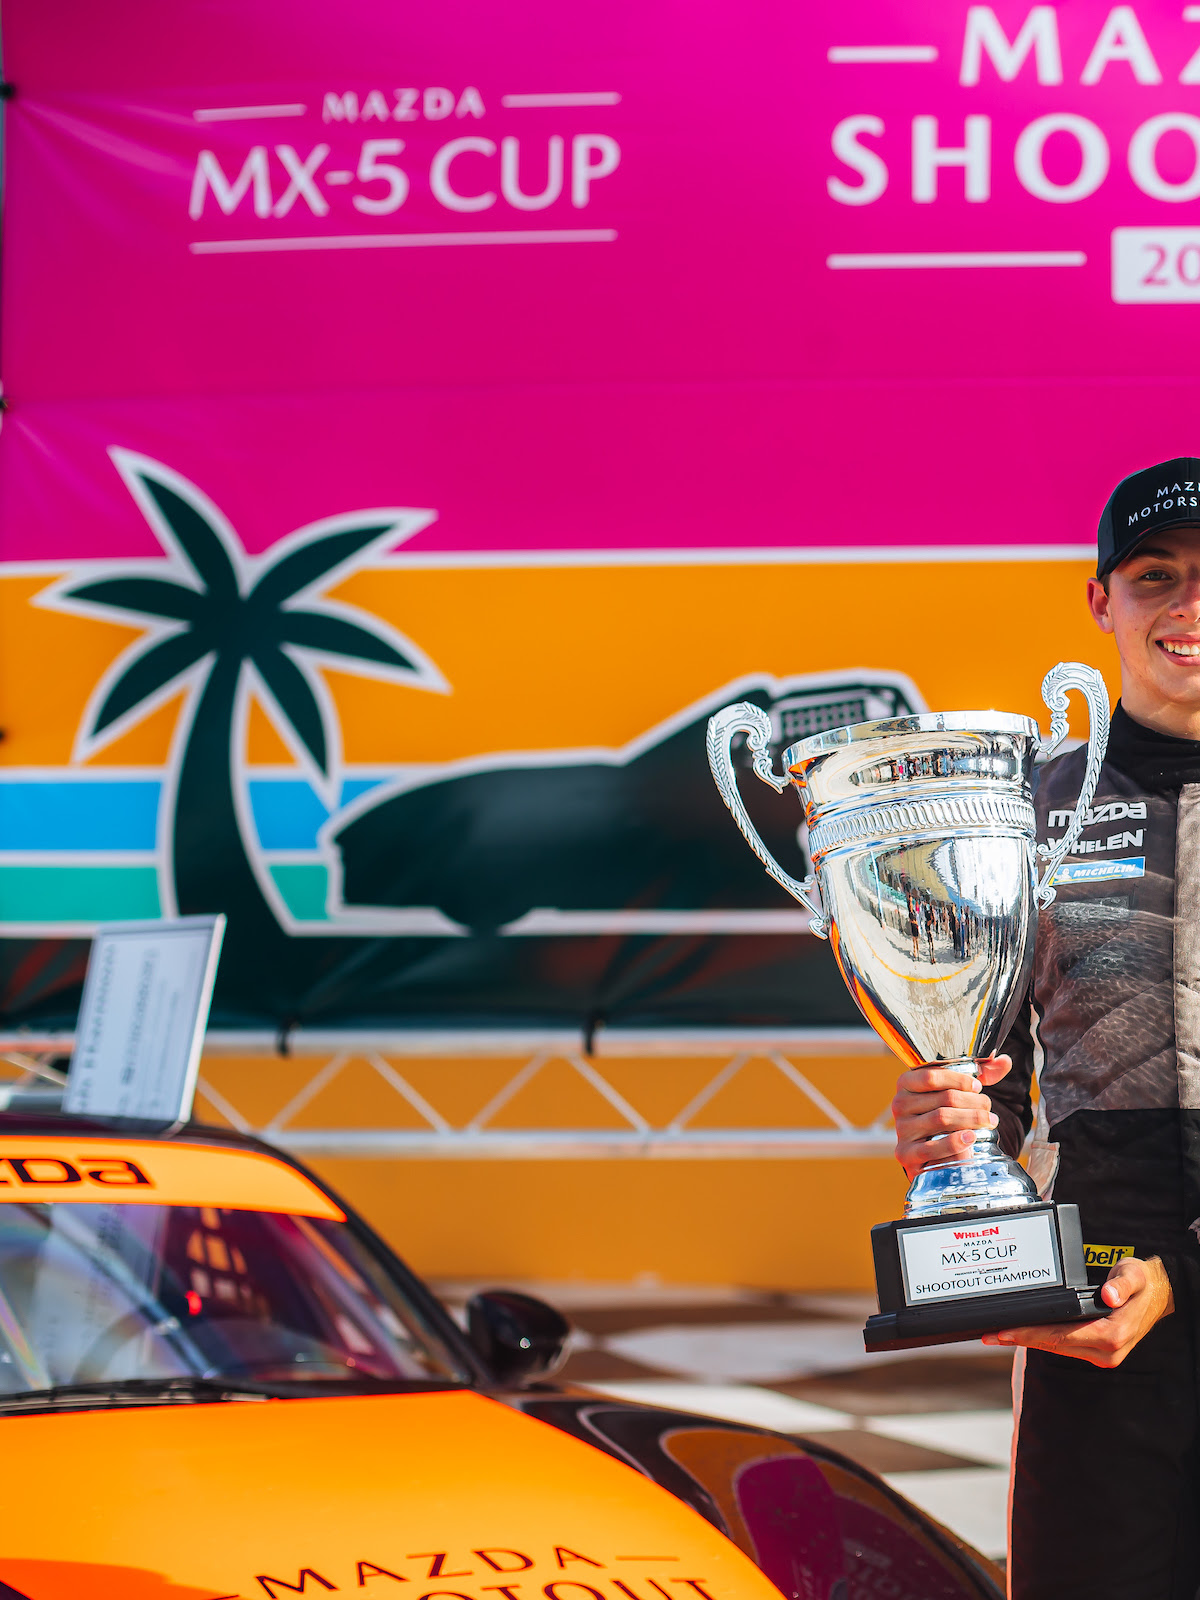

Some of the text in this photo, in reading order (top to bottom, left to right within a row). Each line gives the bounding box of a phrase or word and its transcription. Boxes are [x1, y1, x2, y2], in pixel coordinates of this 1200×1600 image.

[322, 86, 486, 124] MAZDA
[189, 134, 621, 220] MX-5 CUP
[1073, 864, 1136, 878] MICHELIN
[953, 1226, 1000, 1240] WHELEN
[963, 1239, 993, 1247] MAZDA
[941, 1244, 1018, 1266] MX-5 CUP
[915, 1268, 1051, 1294] SHOOTOUT CHAMPION
[255, 1545, 608, 1599] MAZDA
